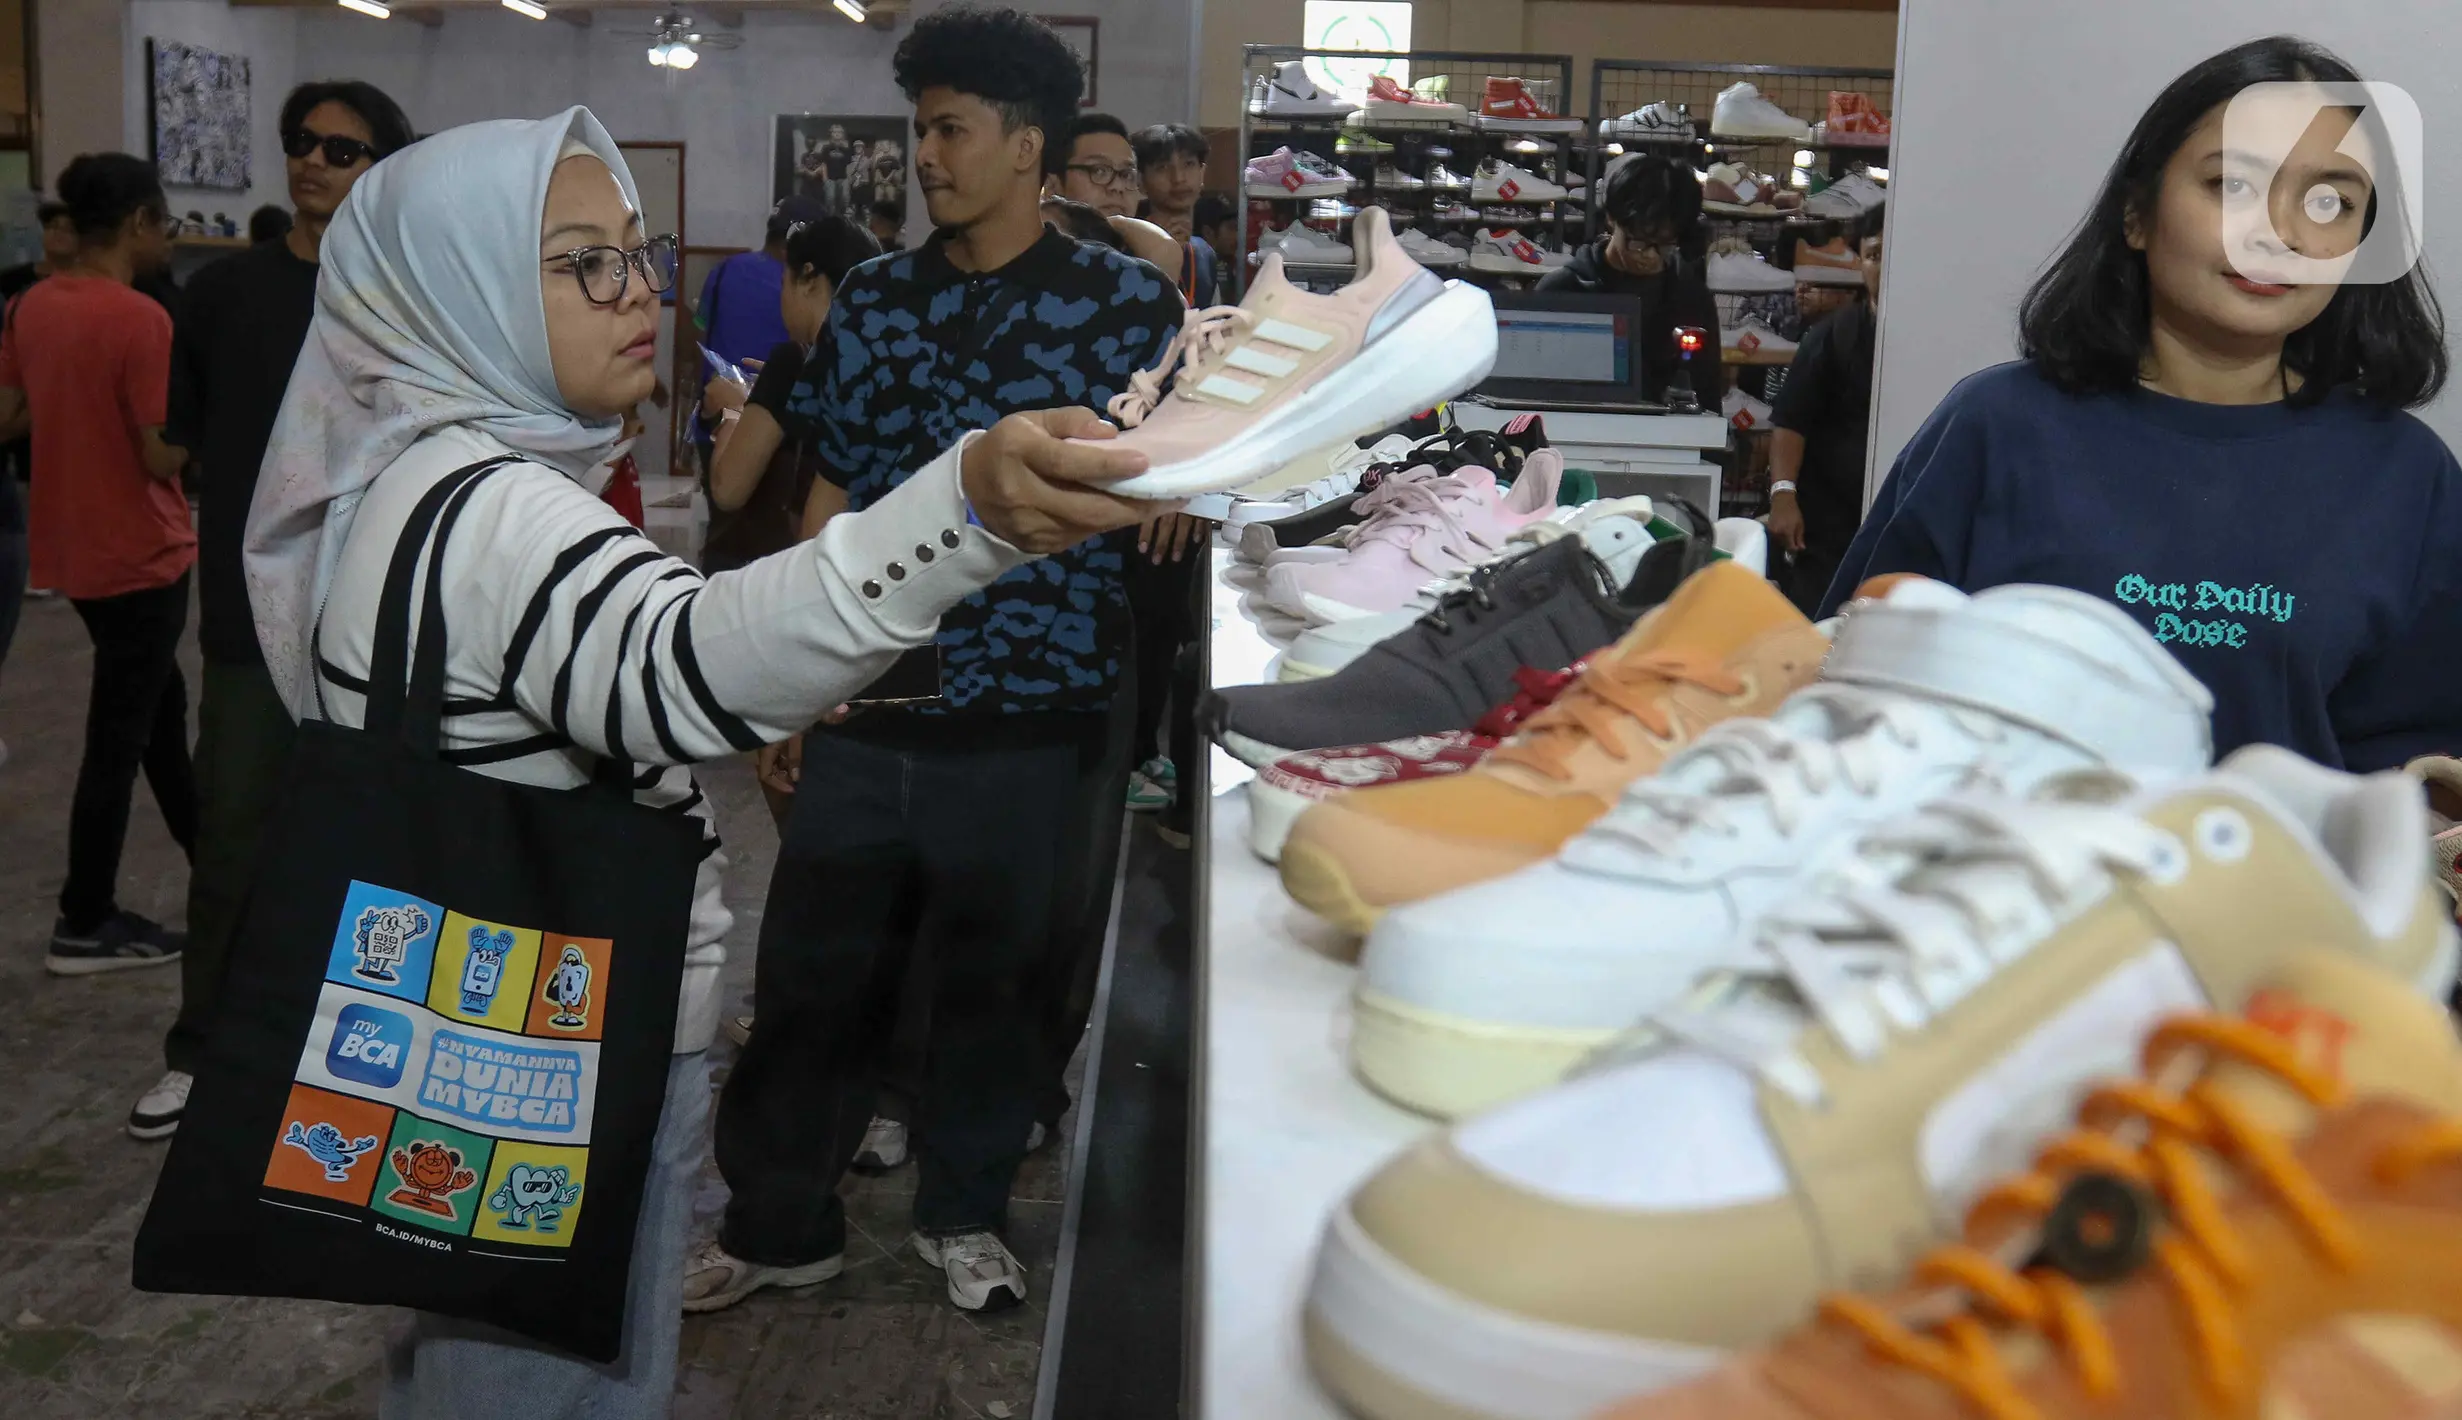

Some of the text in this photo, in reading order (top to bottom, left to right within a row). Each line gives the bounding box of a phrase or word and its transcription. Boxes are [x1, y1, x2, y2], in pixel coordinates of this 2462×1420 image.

[2115, 573, 2295, 622] Our Daily
[2154, 612, 2248, 649] Dose
[353, 1019, 383, 1037] my
[337, 1033, 400, 1070] BCA
[437, 1036, 577, 1071] #NYAMANNYA
[430, 1051, 573, 1100] DUNIA
[424, 1078, 571, 1126] MYBCA
[375, 1222, 452, 1252] BCA.ID/MYBCA
